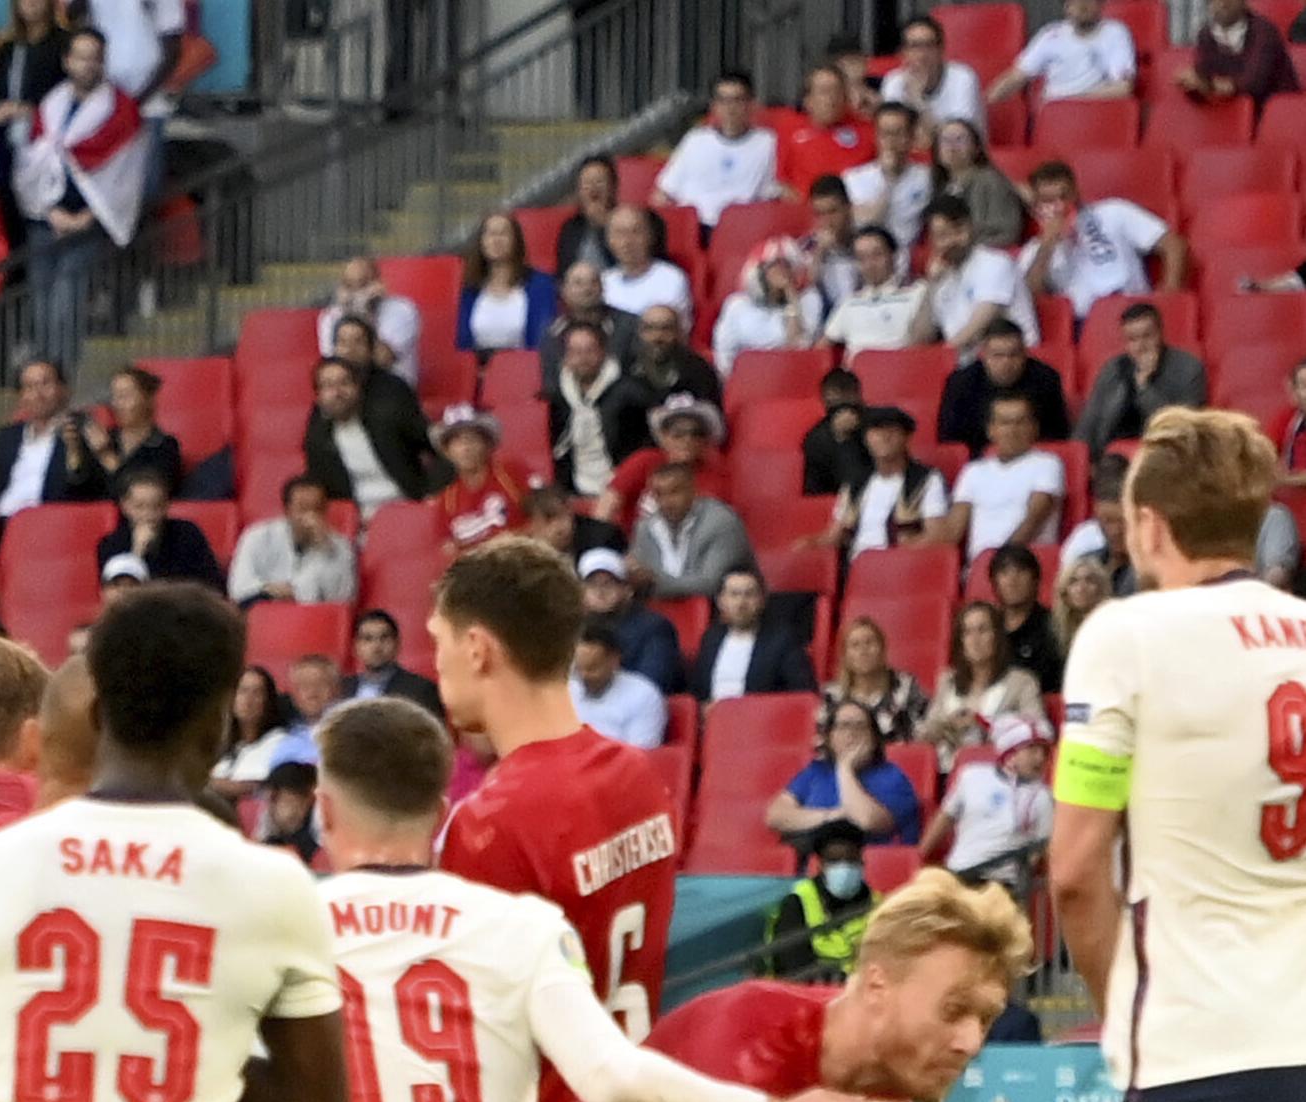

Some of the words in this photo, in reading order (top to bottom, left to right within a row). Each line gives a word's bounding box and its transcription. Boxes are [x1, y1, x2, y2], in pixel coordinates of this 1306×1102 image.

[1261, 680, 1306, 862] 9
[58, 837, 183, 885] SAKA
[329, 901, 461, 939] MOUNT
[608, 901, 651, 1048] 6
